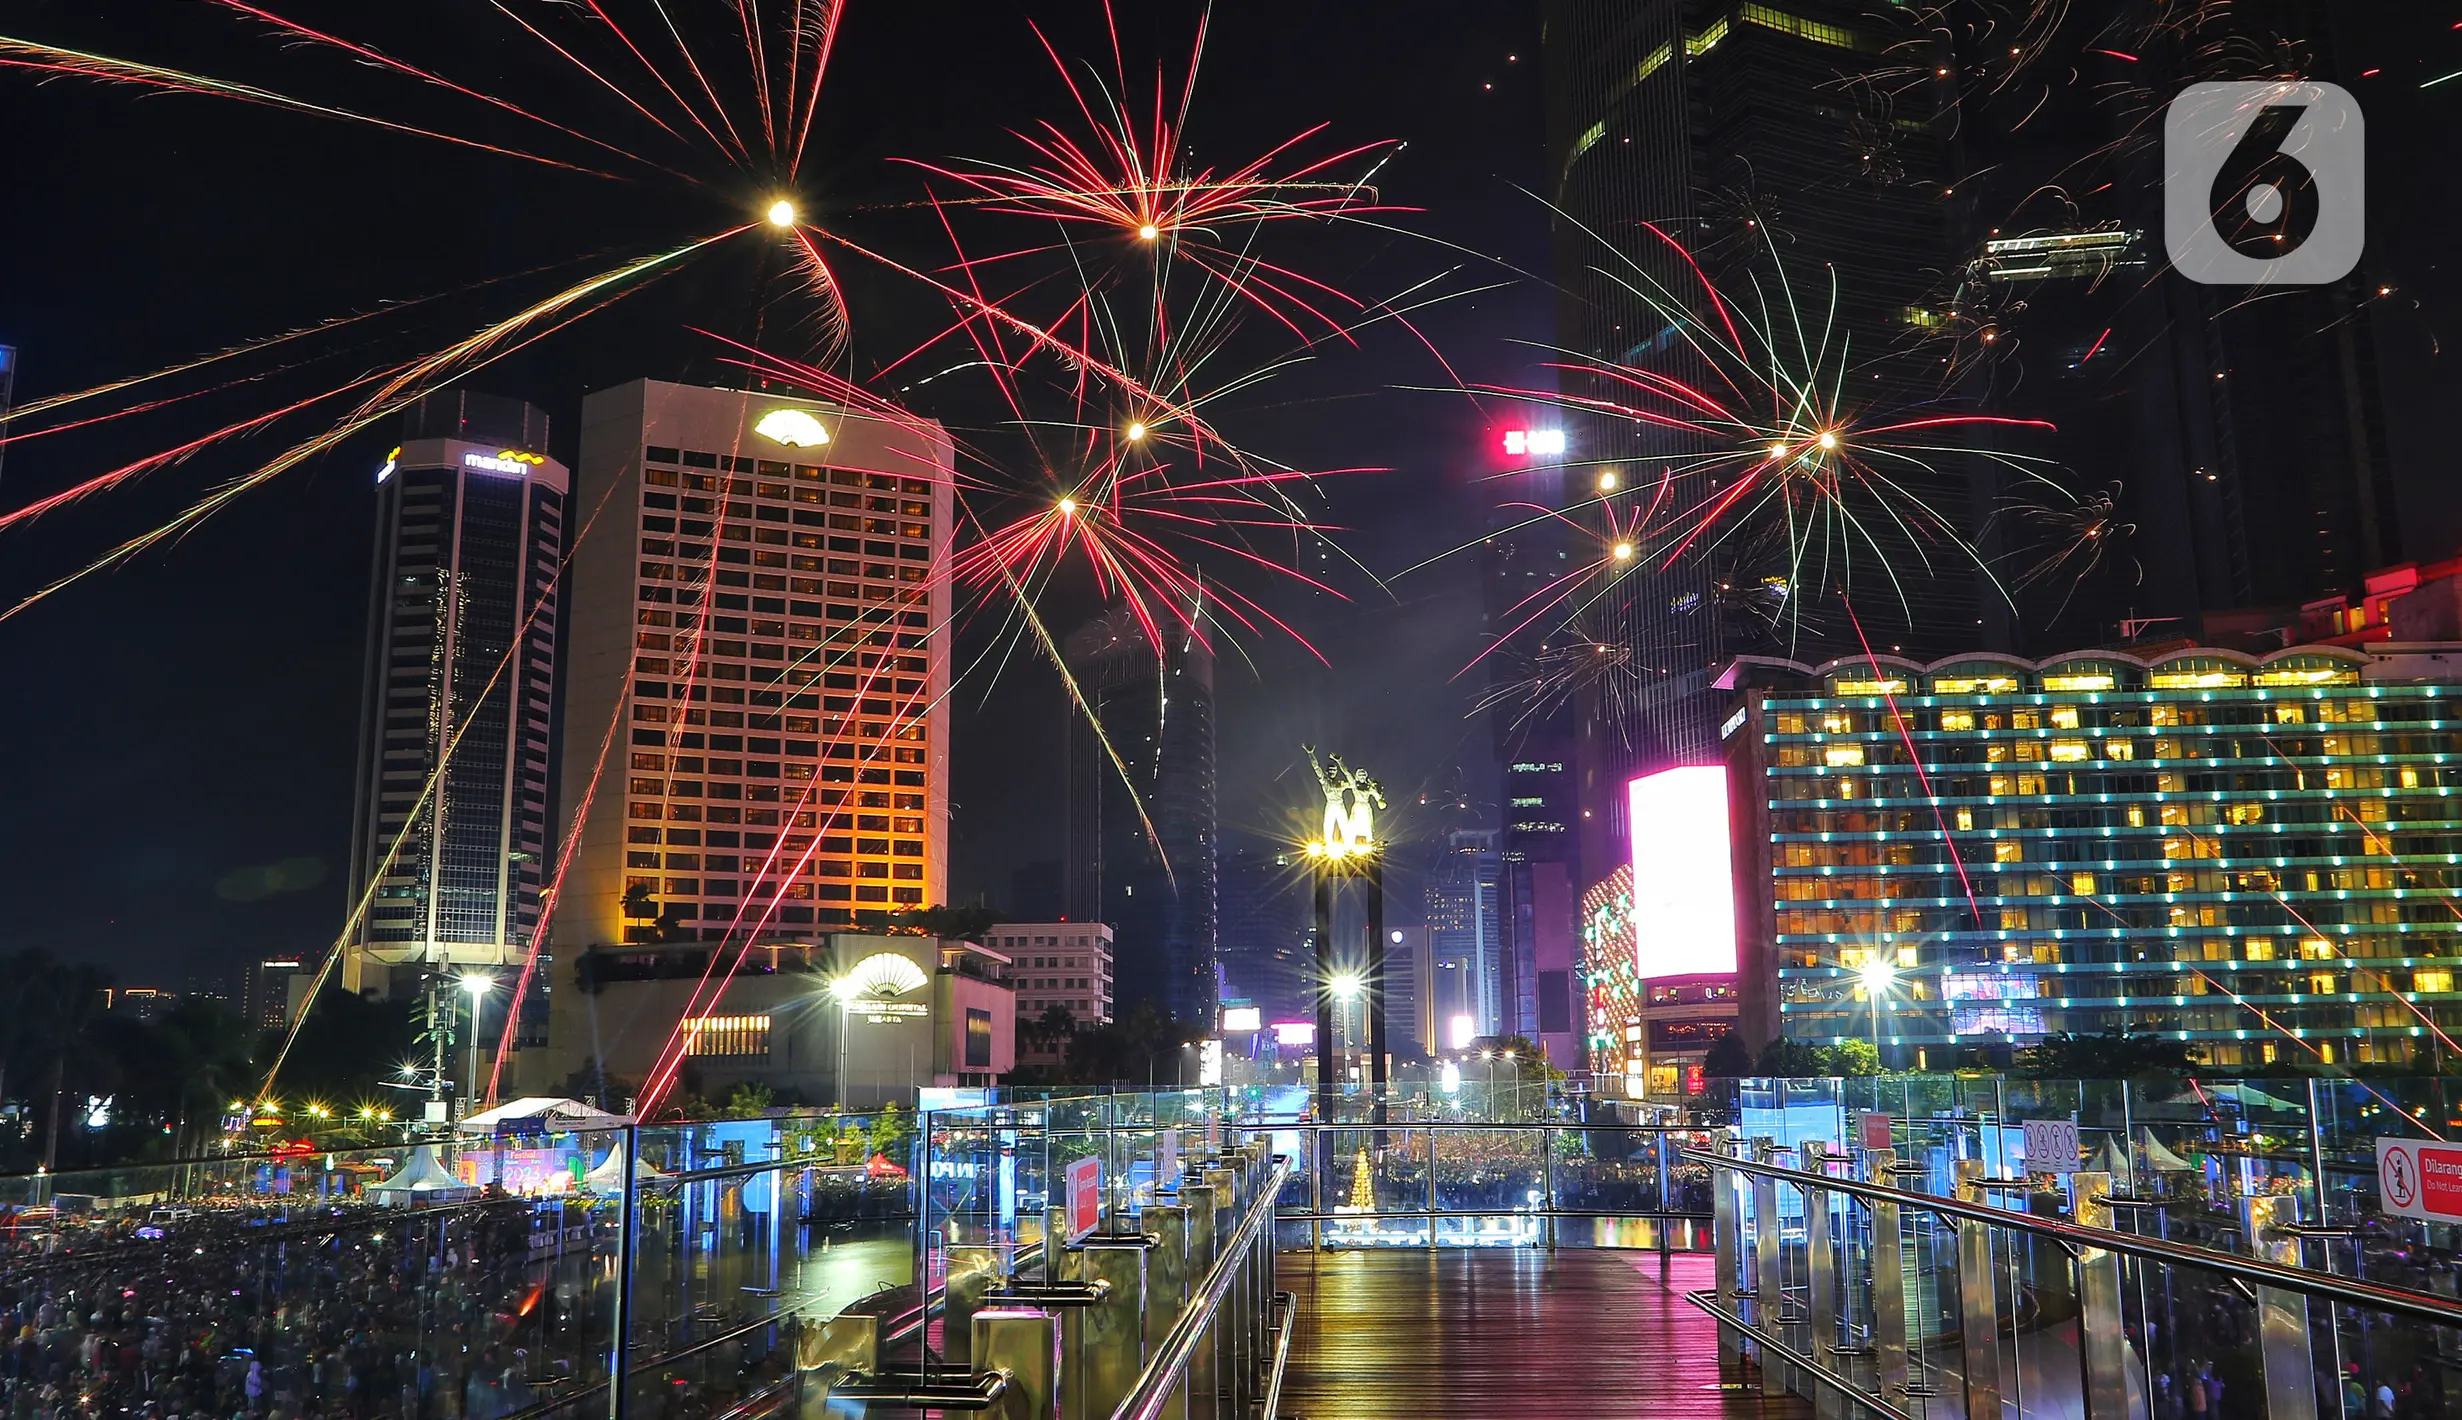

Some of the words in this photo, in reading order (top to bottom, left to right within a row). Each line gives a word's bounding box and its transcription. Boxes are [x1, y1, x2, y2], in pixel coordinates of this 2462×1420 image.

[503, 1165, 540, 1181] 2023
[2424, 1158, 2462, 1180] Dilarang
[2427, 1180, 2436, 1190] Do
[2436, 1181, 2448, 1191] Not
